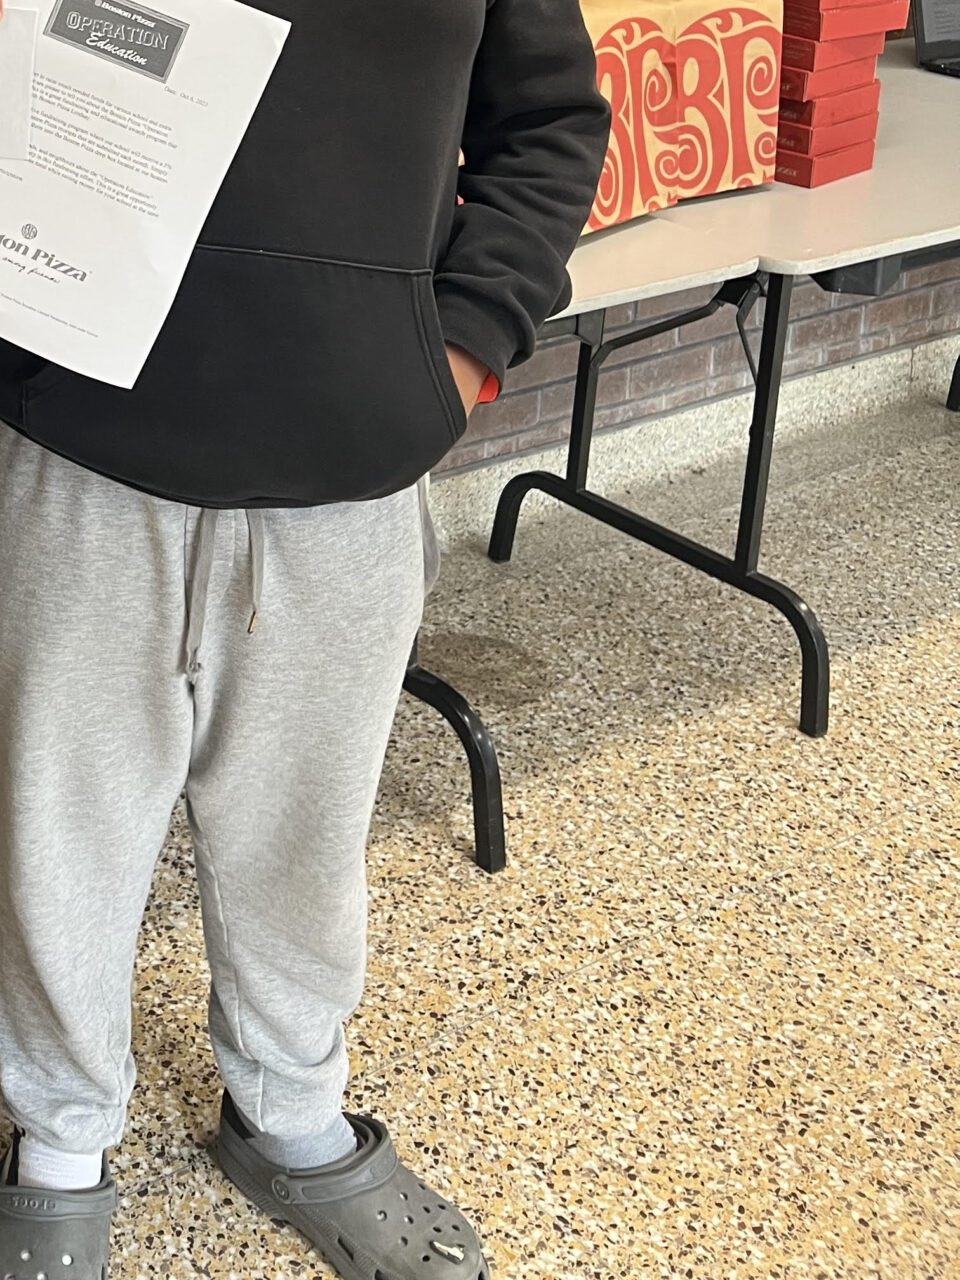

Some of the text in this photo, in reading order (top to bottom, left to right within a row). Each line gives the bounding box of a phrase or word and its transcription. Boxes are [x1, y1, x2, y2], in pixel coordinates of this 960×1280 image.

[66, 11, 170, 51] OPERATION
[100, 0, 156, 28] Boston Pizza
[85, 31, 148, 66] Education
[31, 248, 87, 282] Pizza
